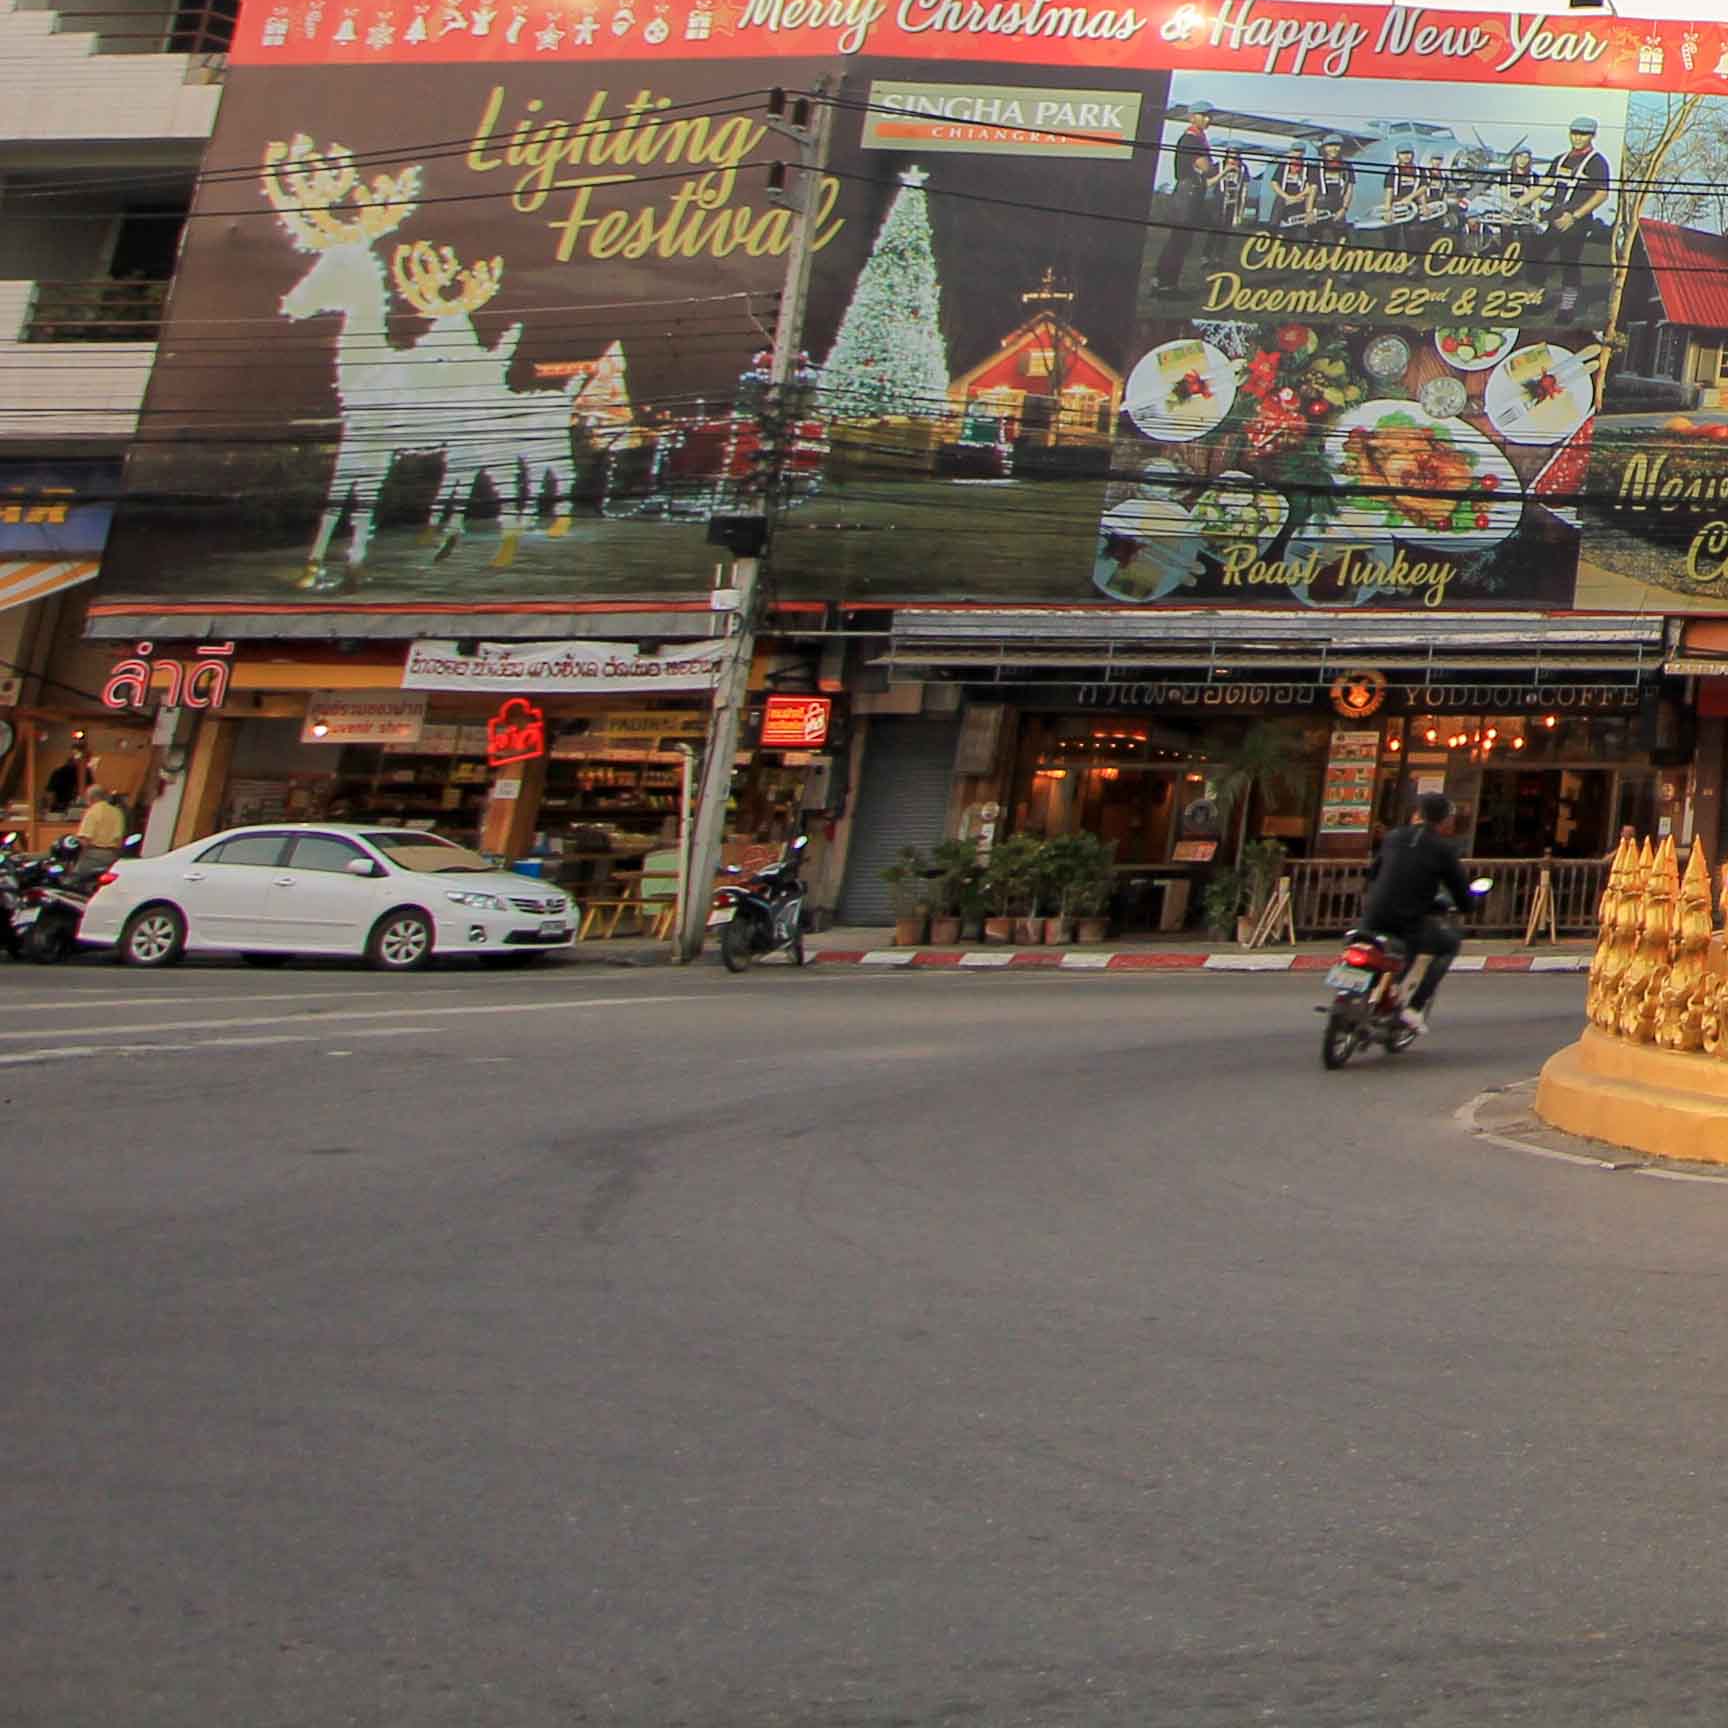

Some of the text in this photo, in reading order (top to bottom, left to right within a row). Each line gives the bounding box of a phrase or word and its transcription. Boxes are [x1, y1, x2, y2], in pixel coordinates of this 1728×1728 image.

[1160, 4, 1200, 40] &
[1207, 0, 1368, 77] Happy
[1374, 6, 1492, 57] New
[1497, 13, 1608, 71] Year
[880, 94, 1126, 129] SINGHA PARK
[466, 86, 768, 212] Lighting
[548, 174, 846, 262] Festival
[1240, 231, 1522, 277] Christmas Carol
[1202, 272, 1545, 318] December 22nd & 23th
[1222, 547, 1458, 607] Roast Turkey
[103, 642, 234, 710] ลำดี
[1403, 684, 1526, 706] YODDOI
